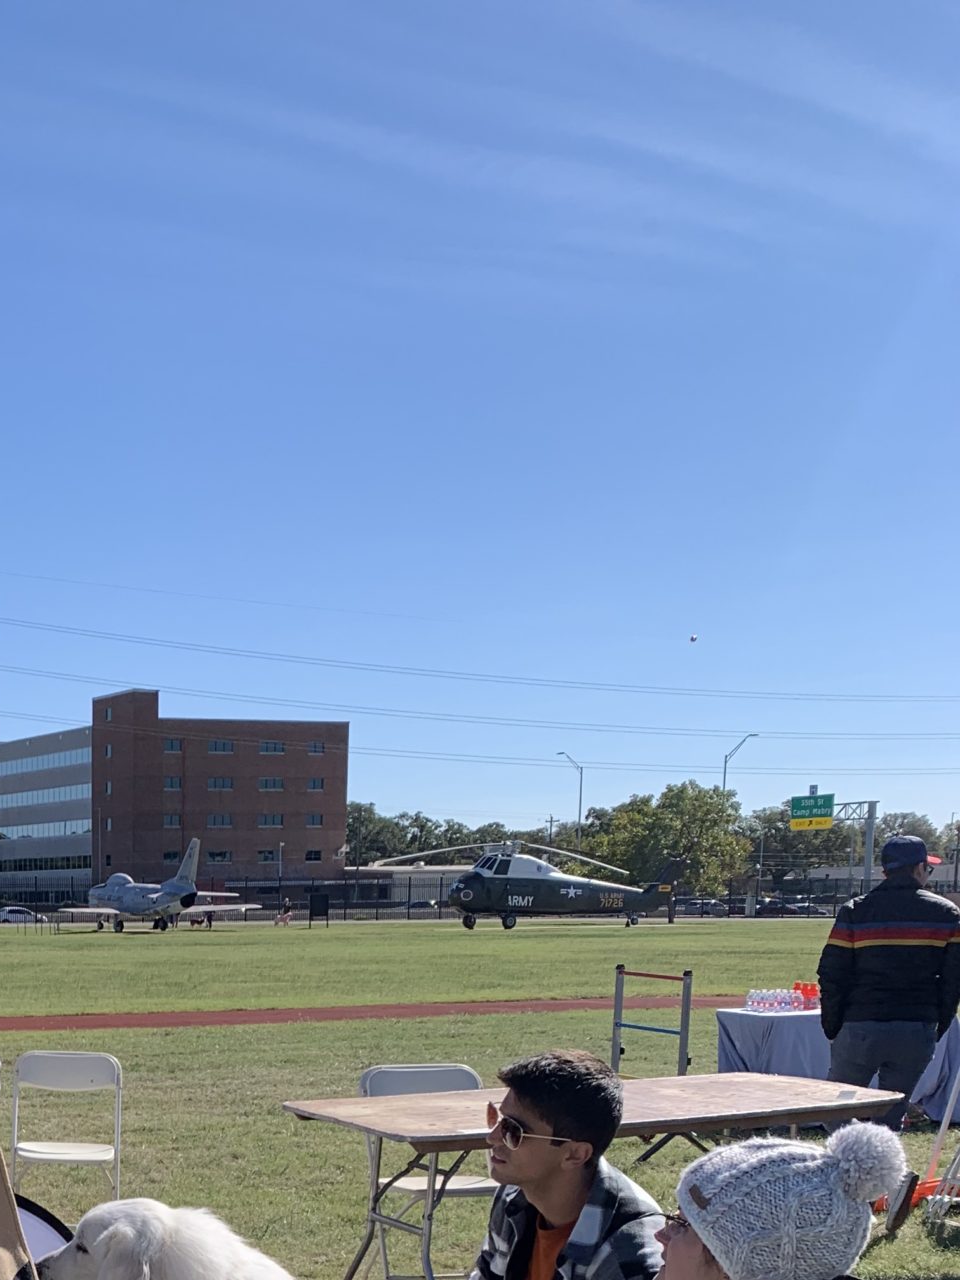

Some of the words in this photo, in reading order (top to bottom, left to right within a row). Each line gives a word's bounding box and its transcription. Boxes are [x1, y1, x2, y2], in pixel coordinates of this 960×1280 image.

[792, 809, 810, 817] Camp
[812, 808, 831, 816] Mabry
[507, 895, 534, 907] ARMY
[599, 899, 624, 908] 71726
